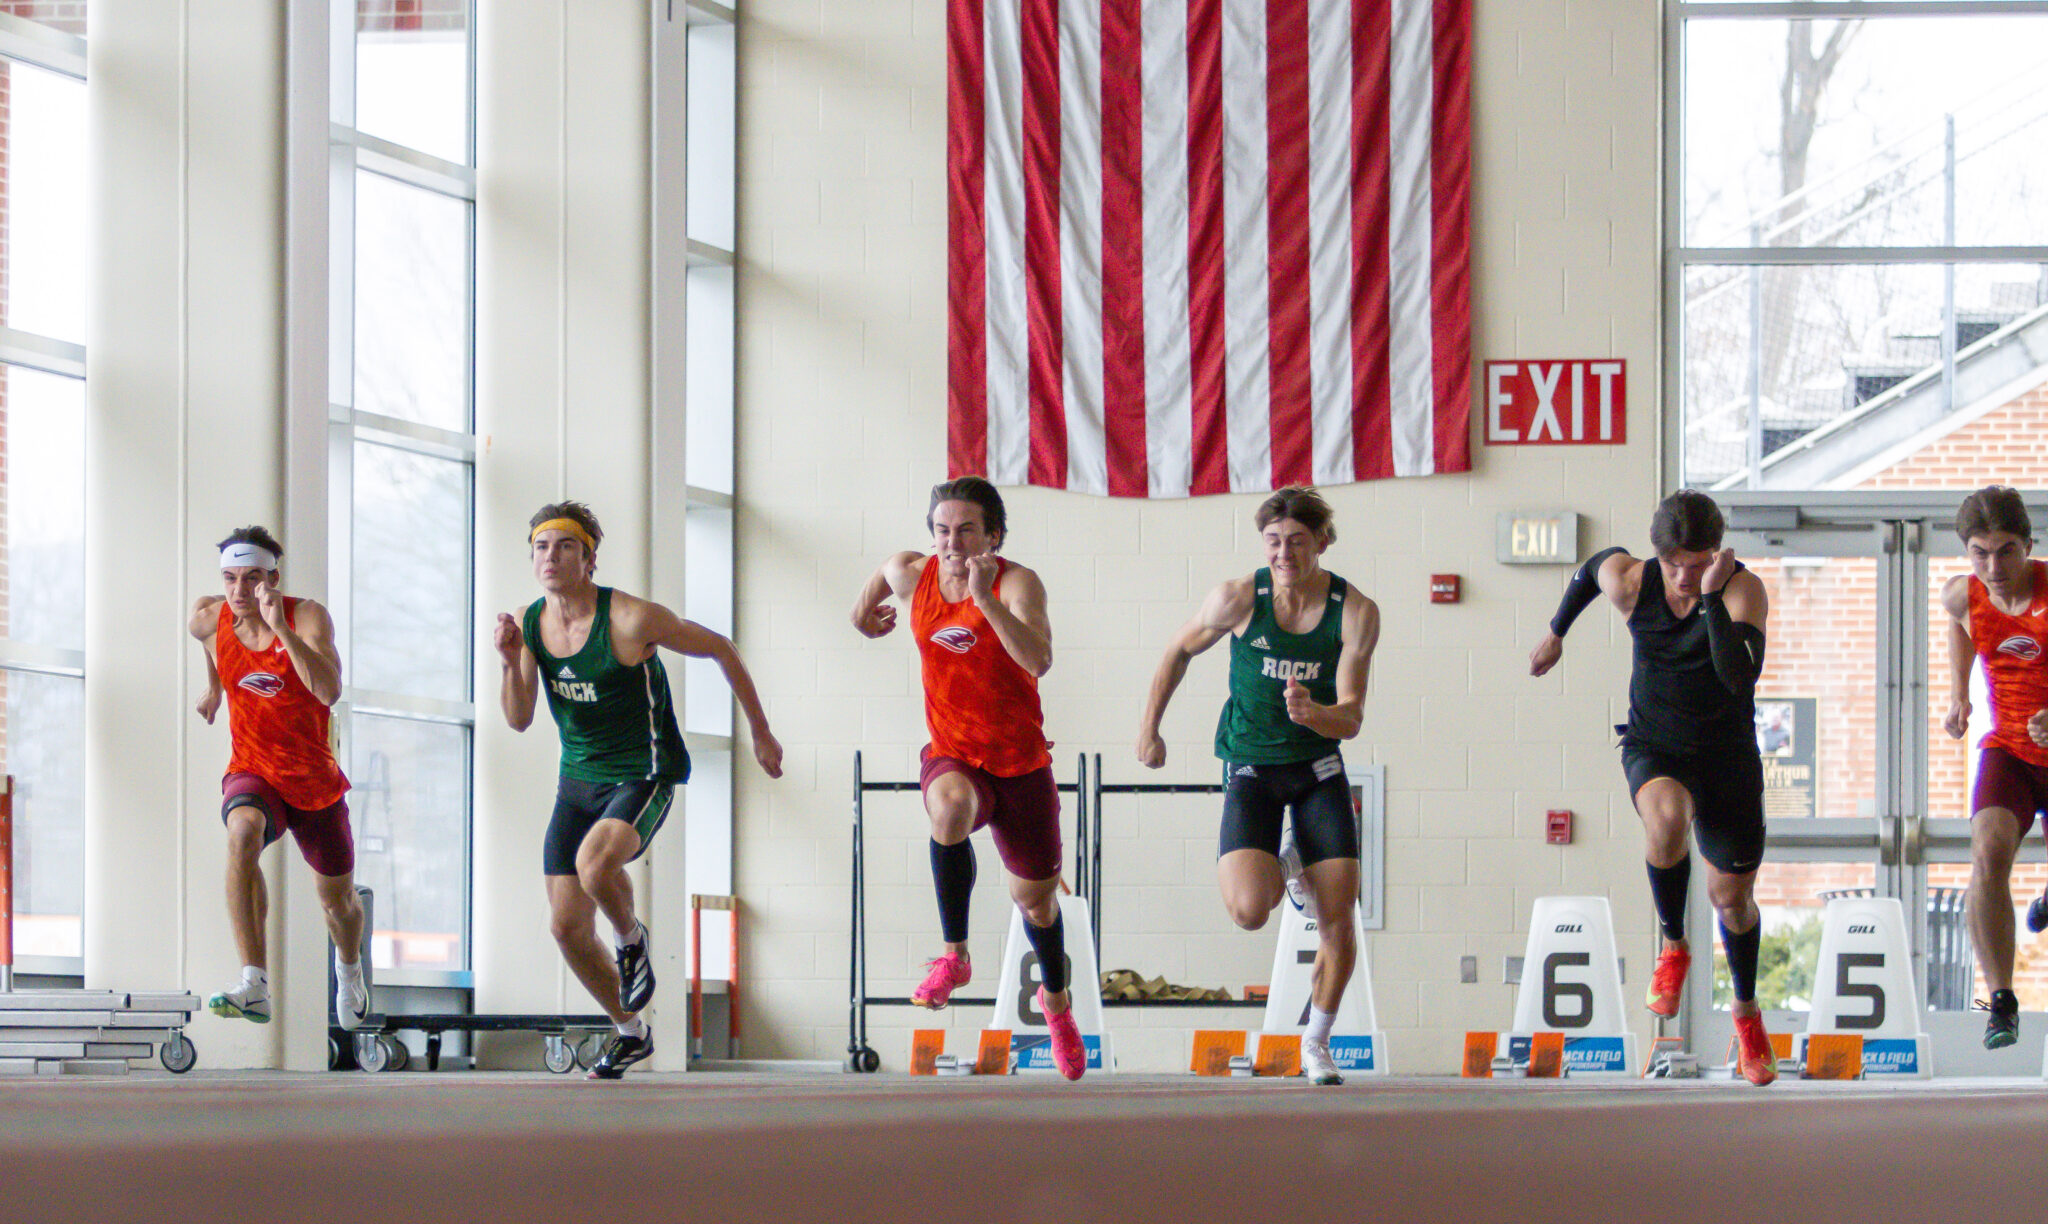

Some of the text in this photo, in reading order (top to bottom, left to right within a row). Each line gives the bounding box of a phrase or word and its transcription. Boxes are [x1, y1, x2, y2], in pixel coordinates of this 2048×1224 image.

[1488, 362, 1622, 441] EXIT
[1512, 519, 1560, 556] EXIT
[1261, 656, 1322, 681] ROCK
[1554, 924, 1584, 933] GILL
[1848, 925, 1876, 934] GILL
[1018, 950, 1072, 1026] 8
[1543, 952, 1593, 1028] 6
[1835, 953, 1885, 1029] 5
[1344, 1048, 1371, 1059] FIELD
[1594, 1051, 1622, 1062] FIELD
[1887, 1052, 1914, 1064] FIELD
